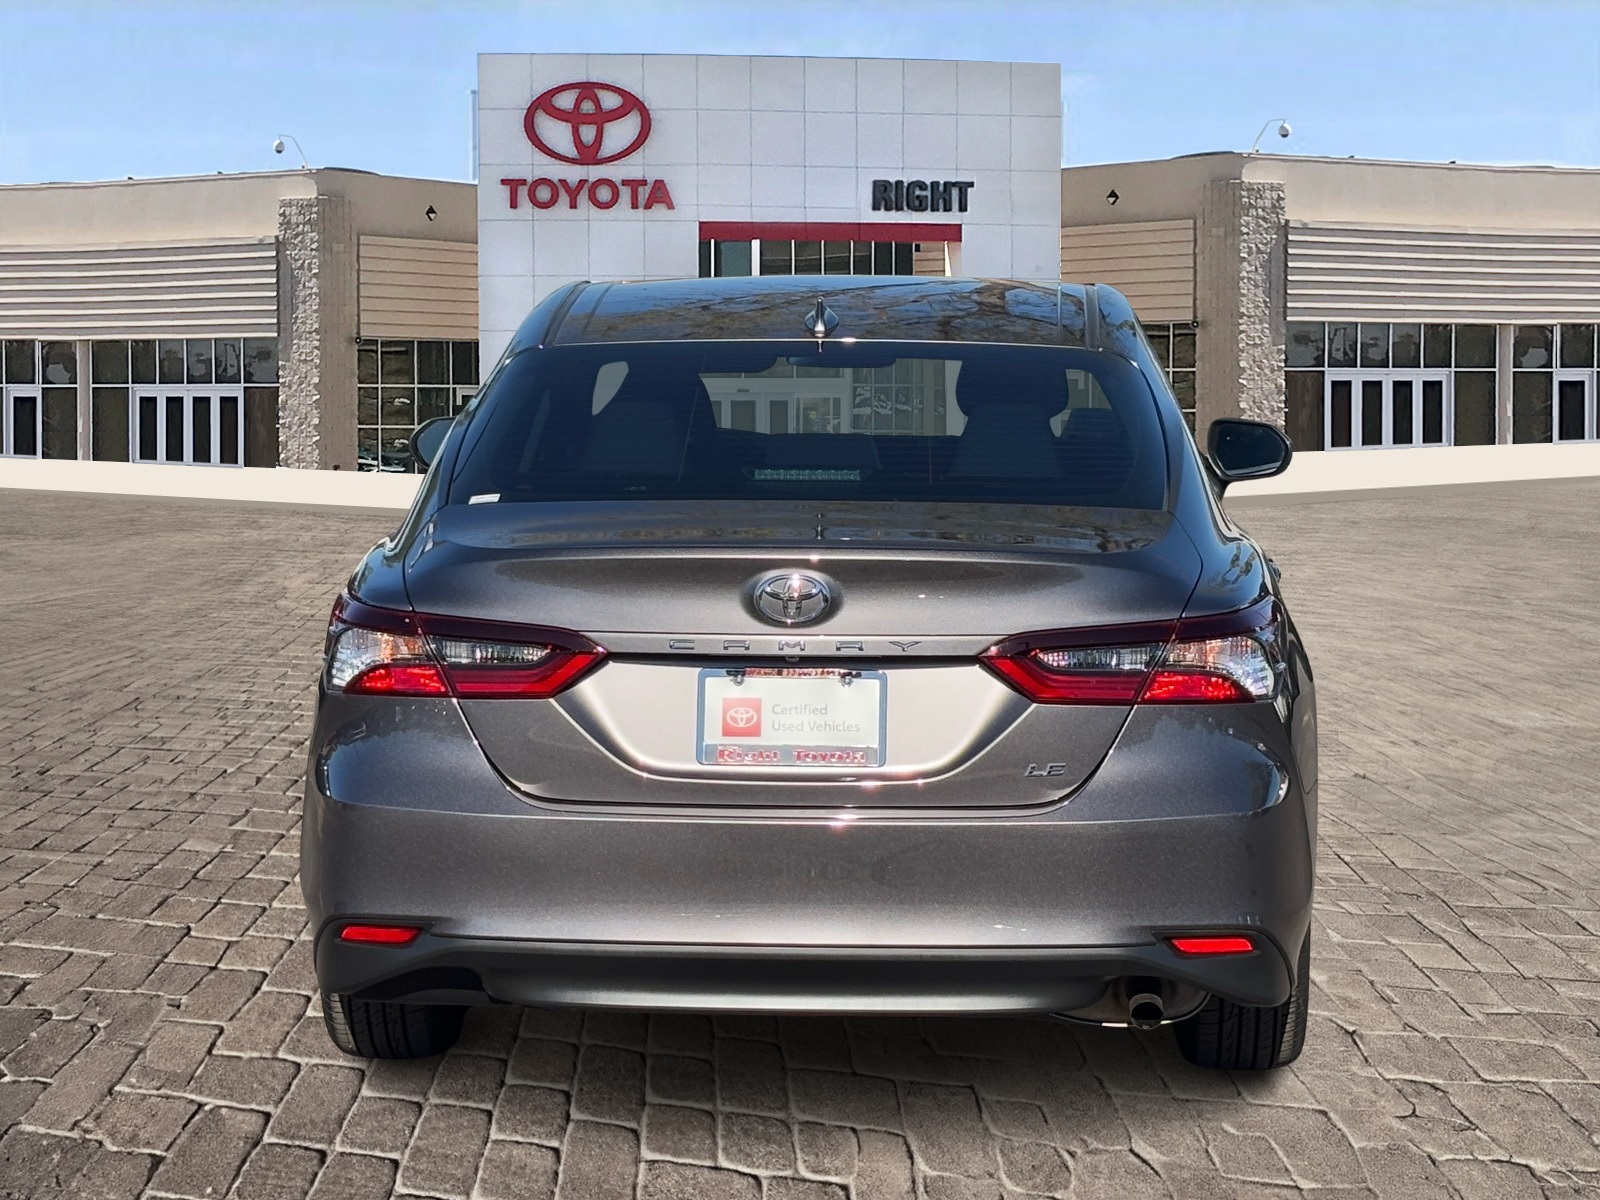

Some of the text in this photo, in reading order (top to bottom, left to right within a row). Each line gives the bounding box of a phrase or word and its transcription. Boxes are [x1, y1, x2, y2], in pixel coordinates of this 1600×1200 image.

[501, 178, 675, 209] TOYOTA
[872, 179, 975, 212] RIGHT
[669, 639, 922, 652] CAMRY
[771, 704, 828, 716] Certified
[771, 720, 860, 732] Used Vehicles
[793, 749, 867, 763] Toyota
[1024, 762, 1067, 777] LE
